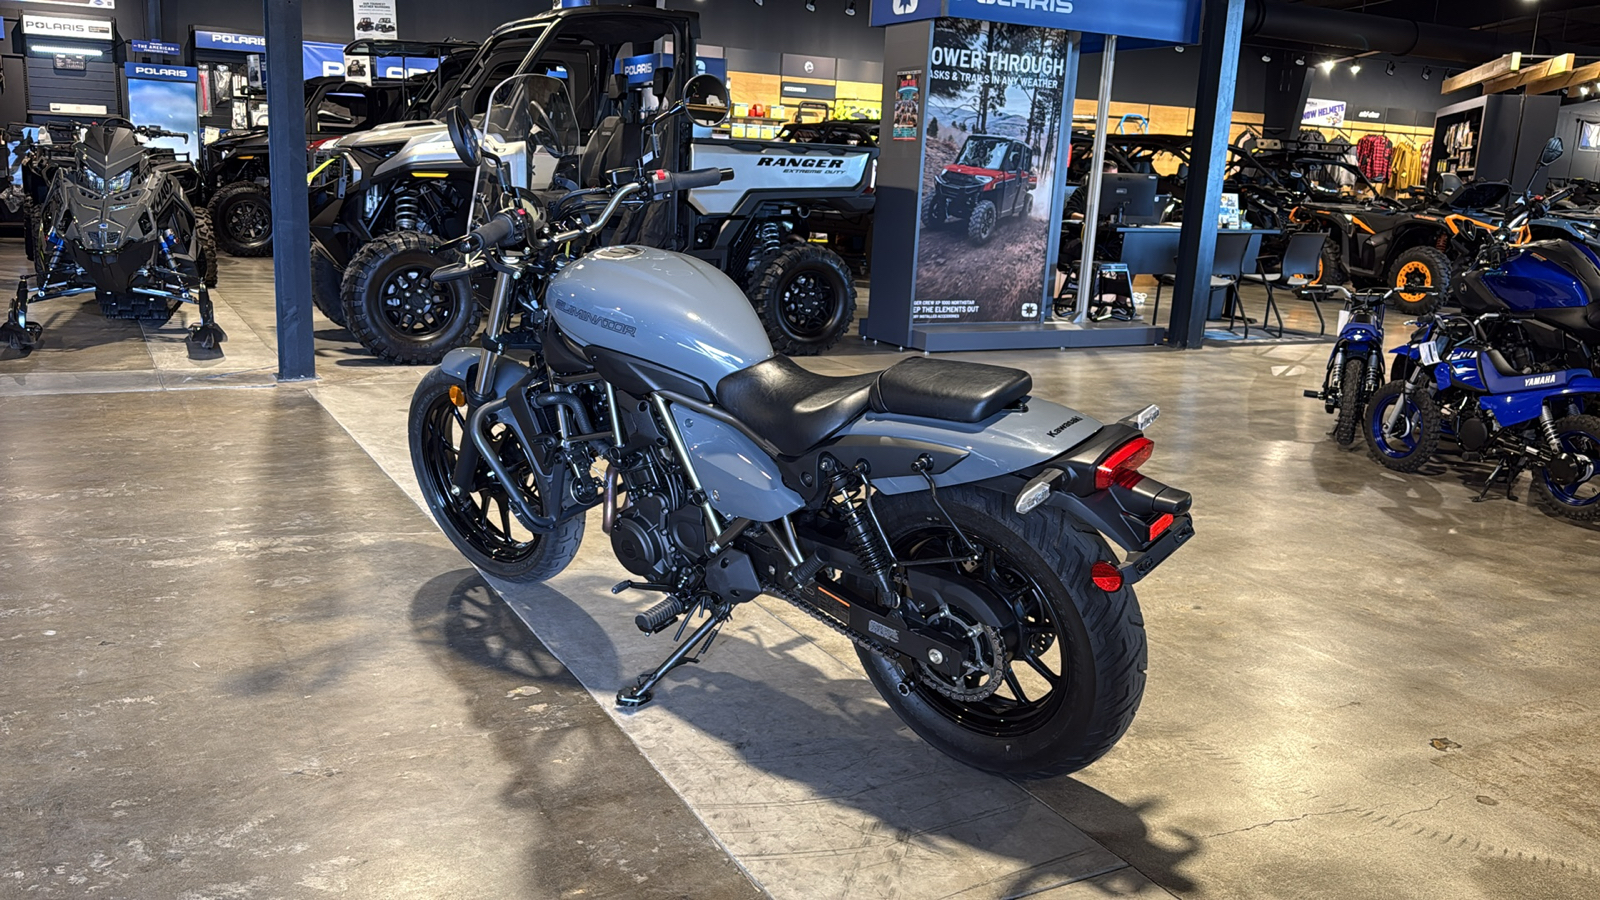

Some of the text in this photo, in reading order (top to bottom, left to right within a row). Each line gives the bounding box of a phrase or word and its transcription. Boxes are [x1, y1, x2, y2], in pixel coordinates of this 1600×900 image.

[26, 20, 84, 32] POLARIS
[625, 63, 653, 76] POLARIS
[987, 51, 1065, 76] THROUGH
[135, 66, 188, 77] POLARIS
[951, 72, 958, 81] &
[961, 72, 990, 84] TRAILS
[991, 75, 1000, 84] IN
[1000, 76, 1019, 87] ANY
[1020, 77, 1058, 89] WEATHER
[1318, 104, 1345, 117] HELMETS
[757, 157, 844, 168] RANGER
[1525, 374, 1556, 386] YAMAHA
[1046, 416, 1083, 438] Kawasaki
